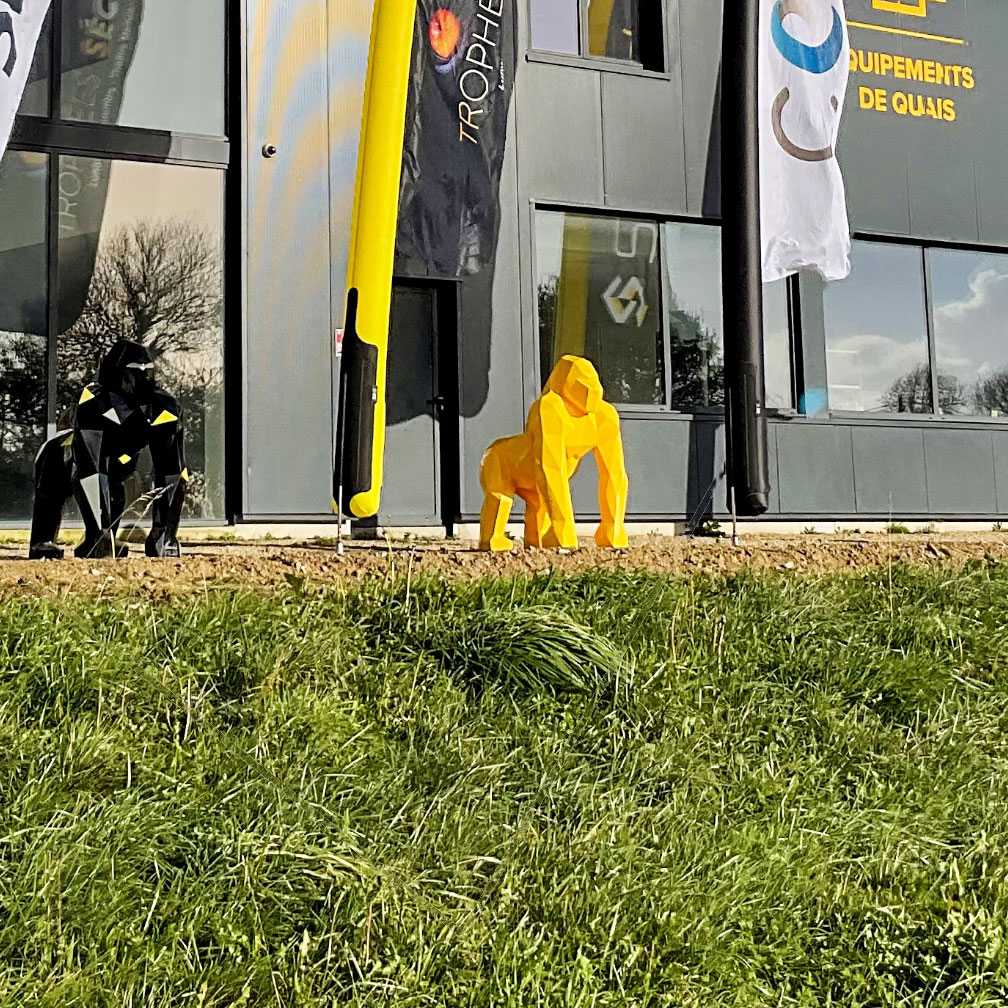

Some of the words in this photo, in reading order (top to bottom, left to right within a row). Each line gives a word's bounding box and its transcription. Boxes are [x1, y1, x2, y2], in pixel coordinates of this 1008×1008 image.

[848, 48, 975, 90] QUIPEMENTS
[859, 86, 888, 112] DE
[891, 90, 956, 122] QUAIS
